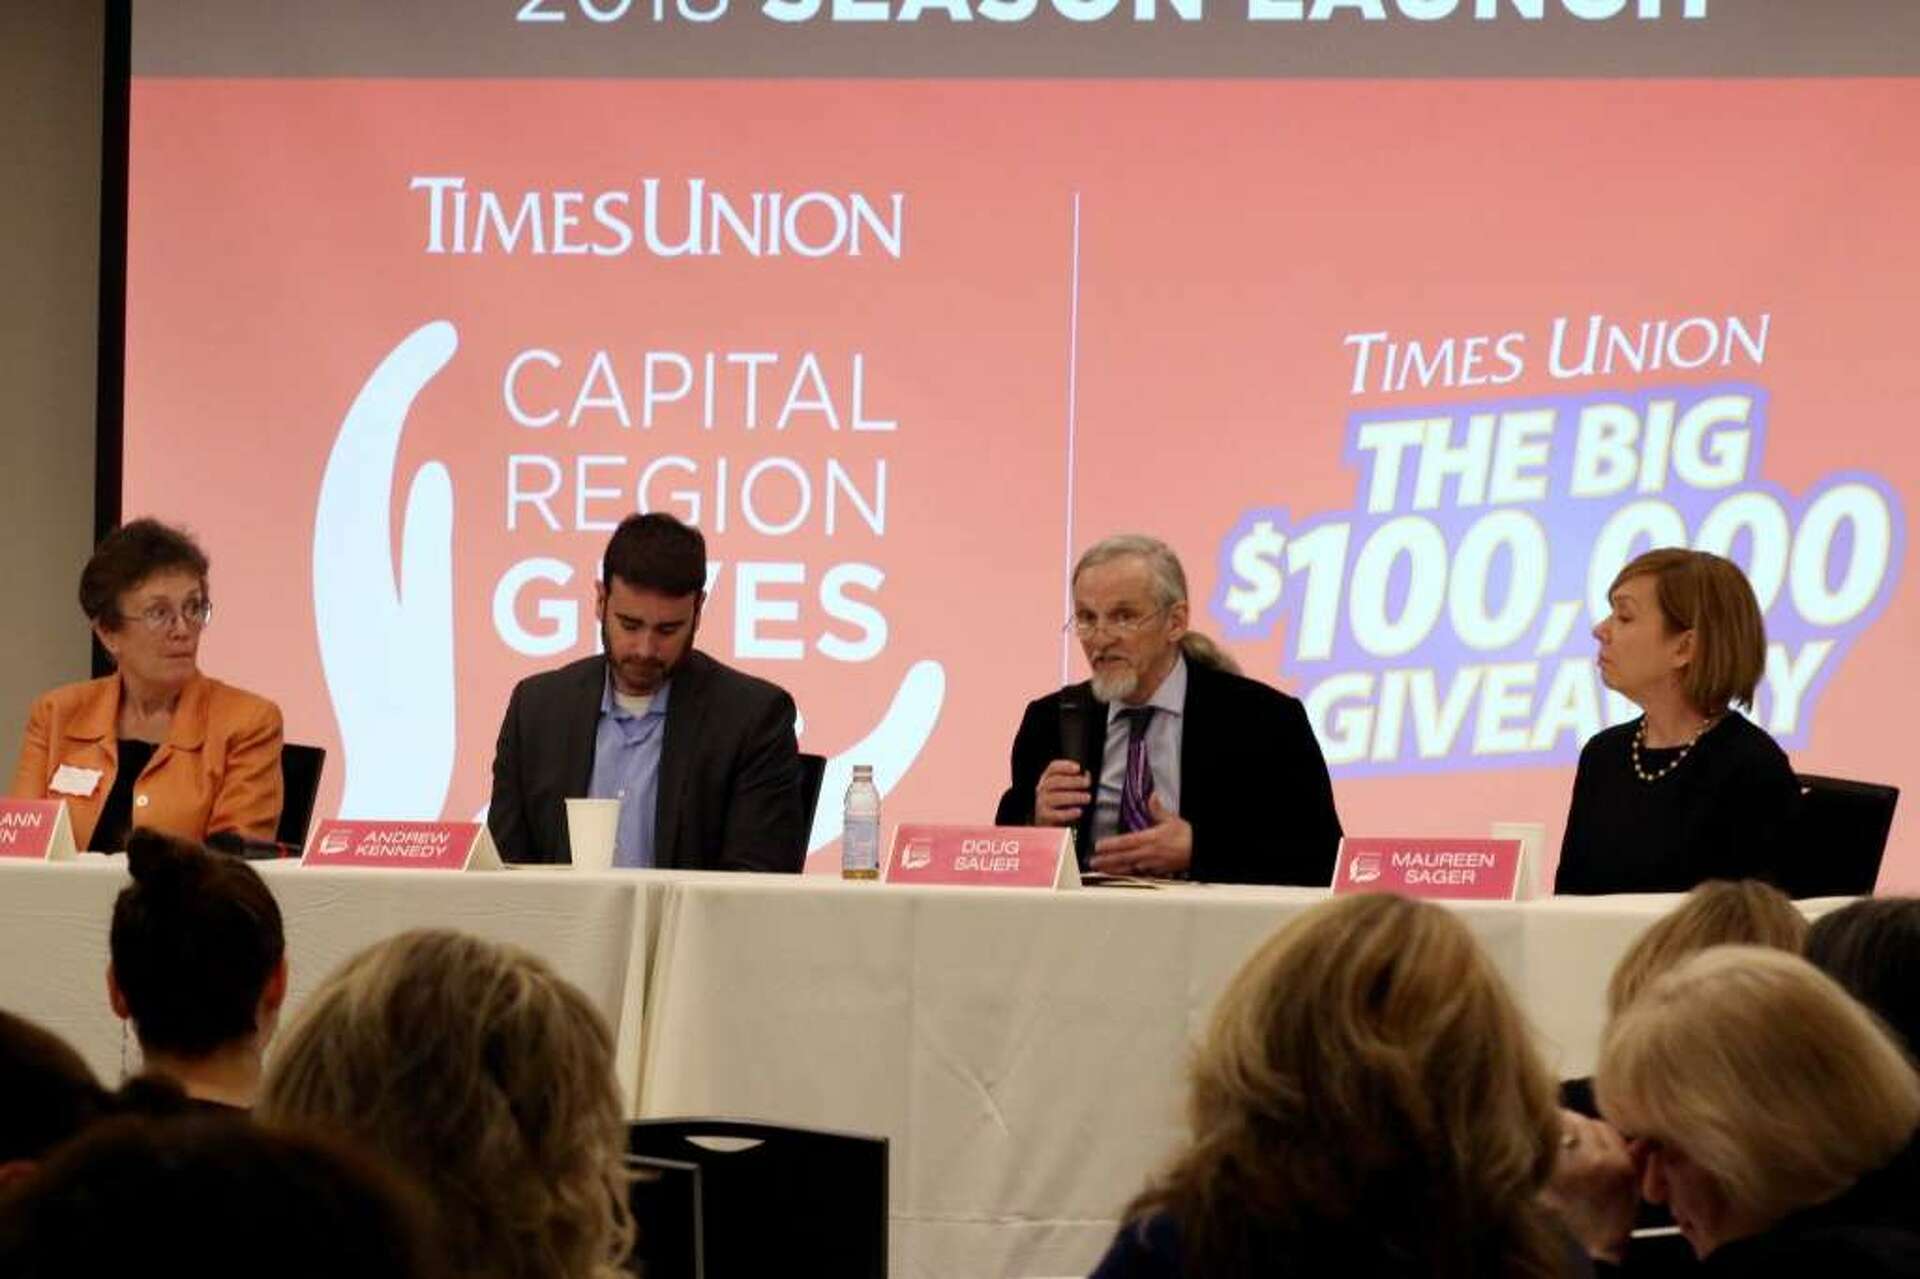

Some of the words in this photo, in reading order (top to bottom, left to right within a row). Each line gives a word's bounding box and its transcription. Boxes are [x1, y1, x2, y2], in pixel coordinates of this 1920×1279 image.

[503, 349, 897, 431] CAPITAL
[1357, 408, 1558, 515] THE
[1569, 394, 1753, 498] BIG
[506, 454, 887, 536] REGION
[492, 557, 889, 662] GES
[1304, 639, 1838, 765] GIVEAY
[363, 831, 450, 845] ANDREW
[355, 844, 448, 858] KENNEDY
[961, 839, 1020, 855] DOUG
[954, 856, 1019, 872] SAUER
[1391, 852, 1496, 868] MAUREEN
[1404, 869, 1476, 884] SAGER
